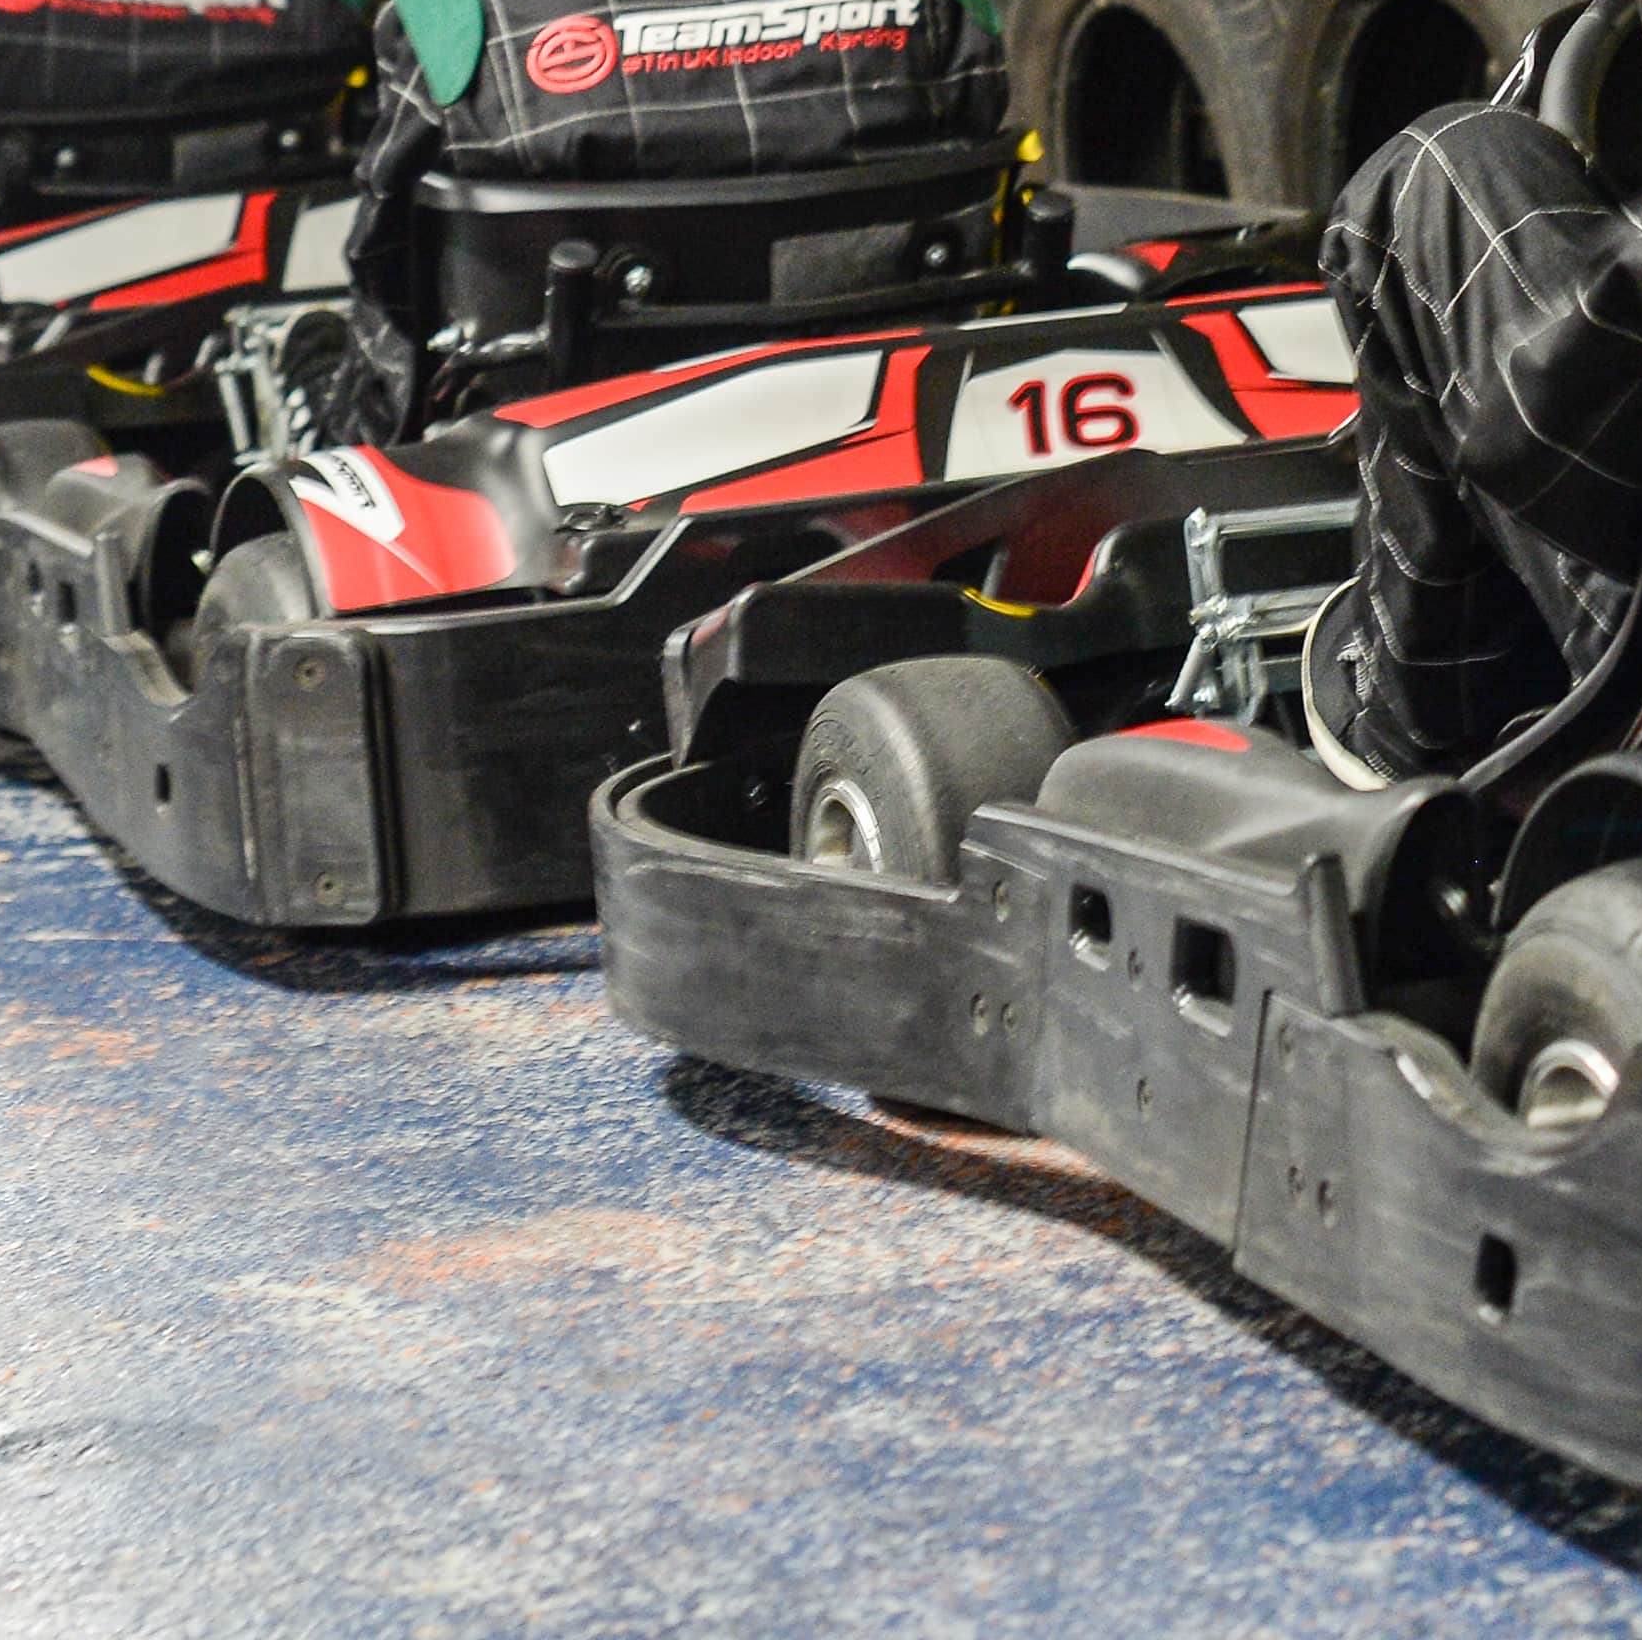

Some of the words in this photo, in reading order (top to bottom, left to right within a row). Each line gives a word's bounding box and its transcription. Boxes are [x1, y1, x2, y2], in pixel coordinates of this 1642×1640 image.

[682, 46, 719, 71] UK
[721, 38, 804, 67] Indoor
[819, 26, 910, 53] Karting
[1004, 371, 1142, 456] 16
